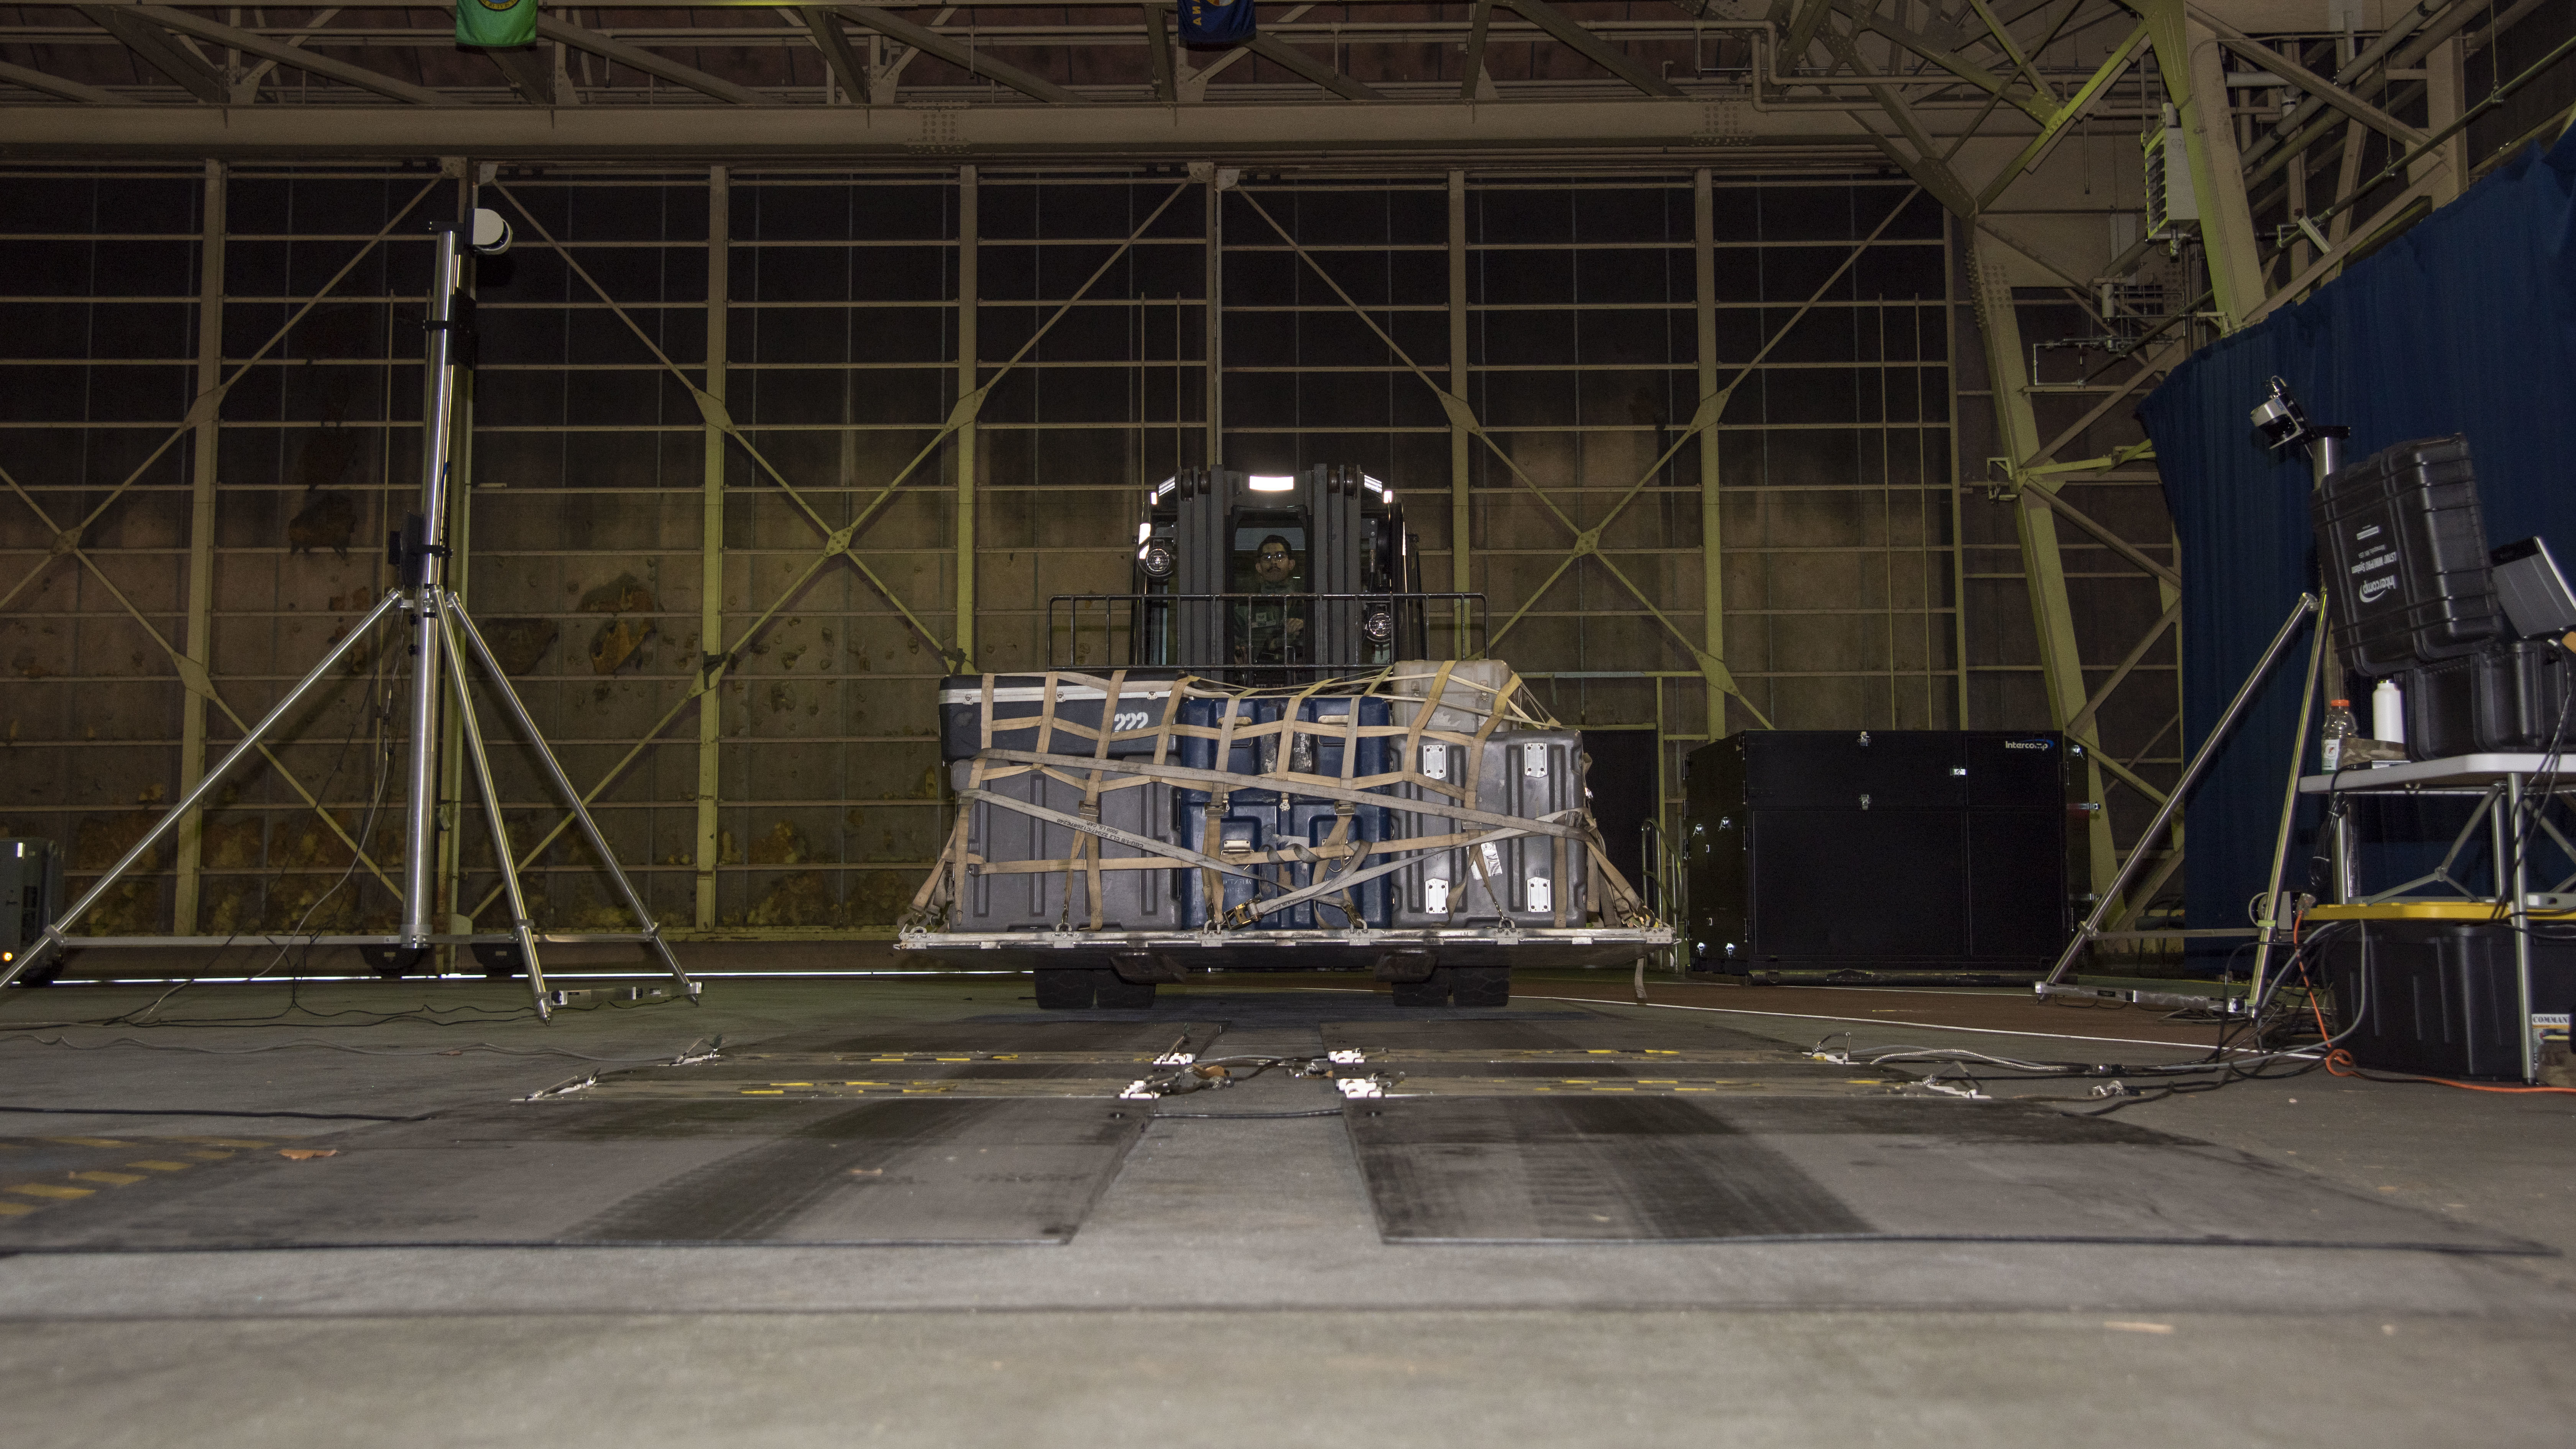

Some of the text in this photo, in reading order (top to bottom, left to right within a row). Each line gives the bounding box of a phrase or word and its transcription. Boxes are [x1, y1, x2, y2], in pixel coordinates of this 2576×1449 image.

[2274, 398, 2285, 411] SICK
[2351, 562, 2366, 574] System
[2362, 575, 2395, 594] Intercomp
[1121, 838, 1144, 848] CGU-1/B
